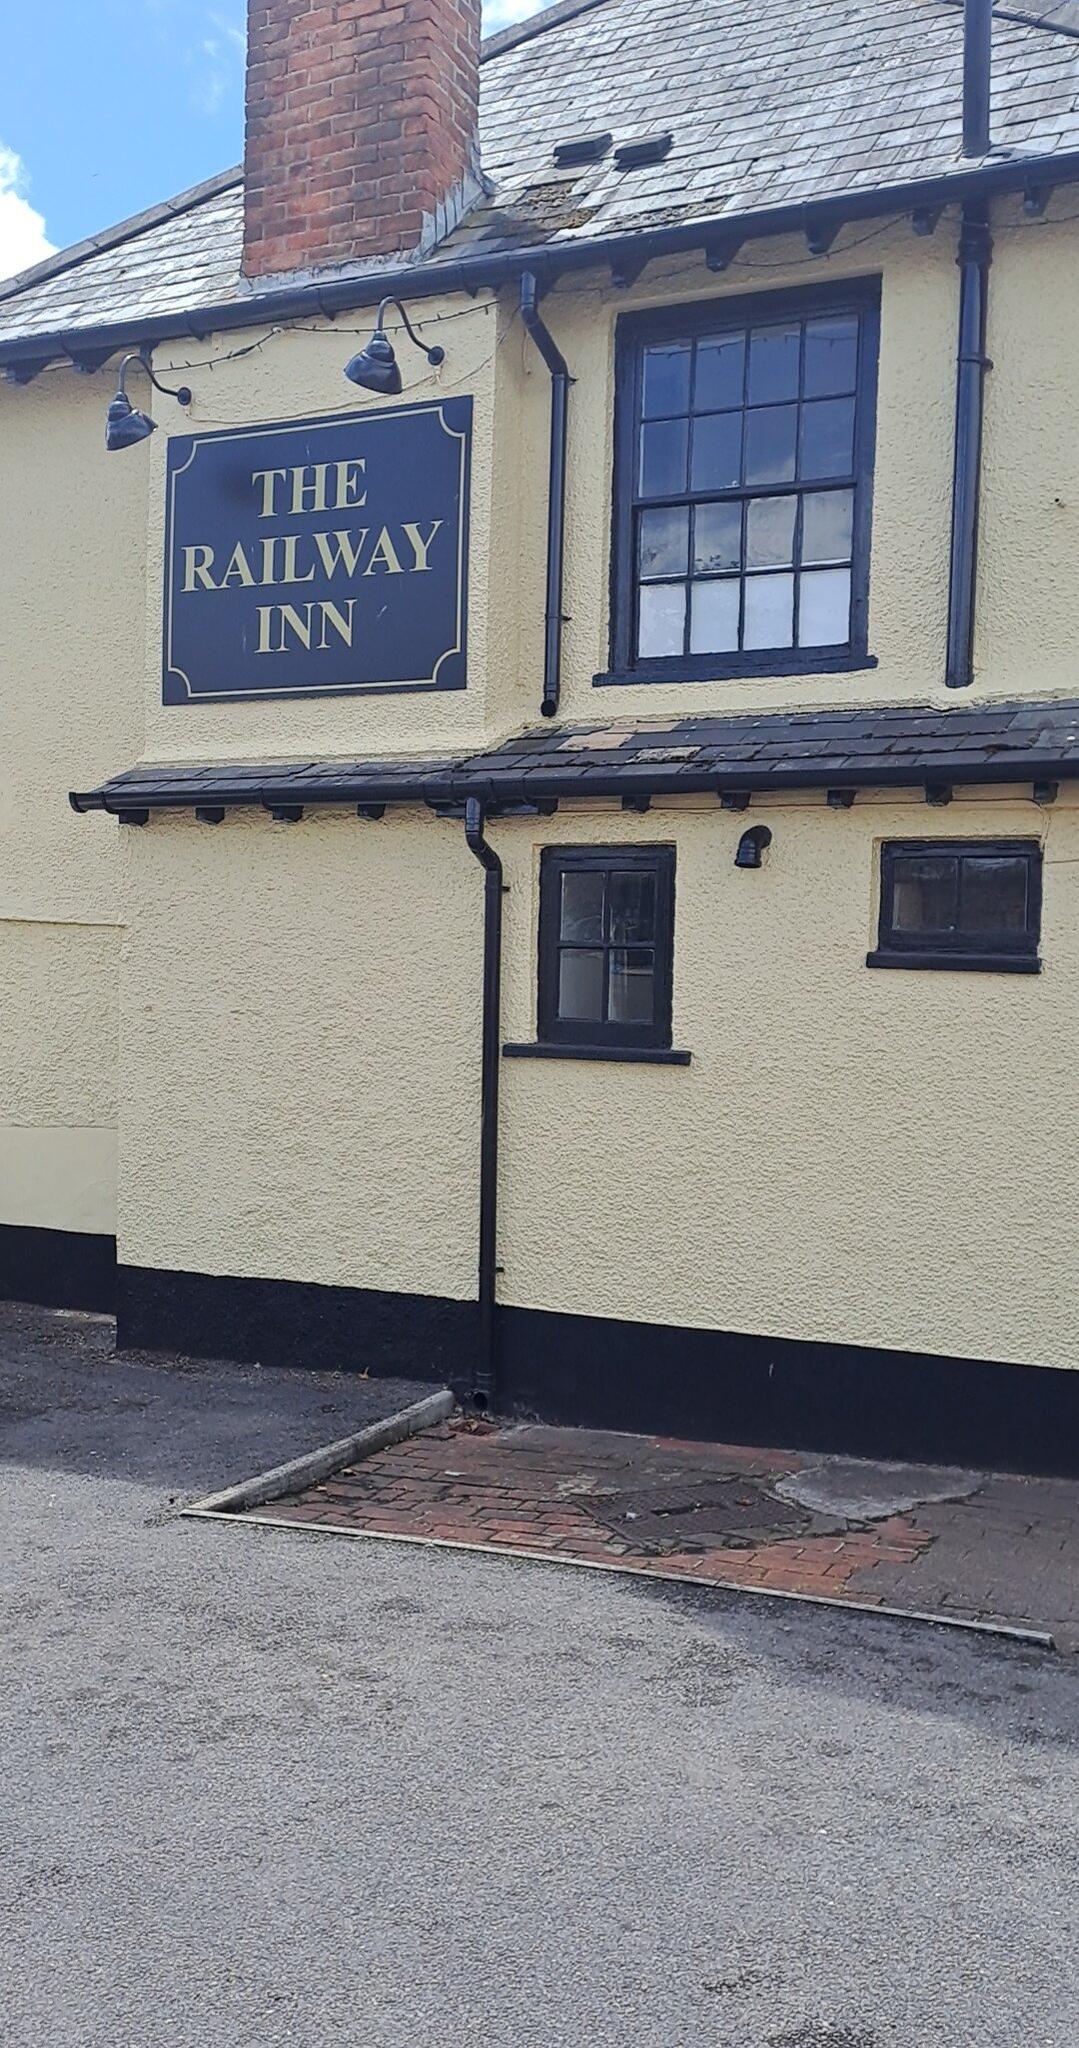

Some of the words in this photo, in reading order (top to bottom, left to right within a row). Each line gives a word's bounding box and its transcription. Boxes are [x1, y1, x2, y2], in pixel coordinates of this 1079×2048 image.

[252, 458, 367, 518] THE
[180, 519, 444, 593] RAILWAY
[253, 599, 358, 653] INN
